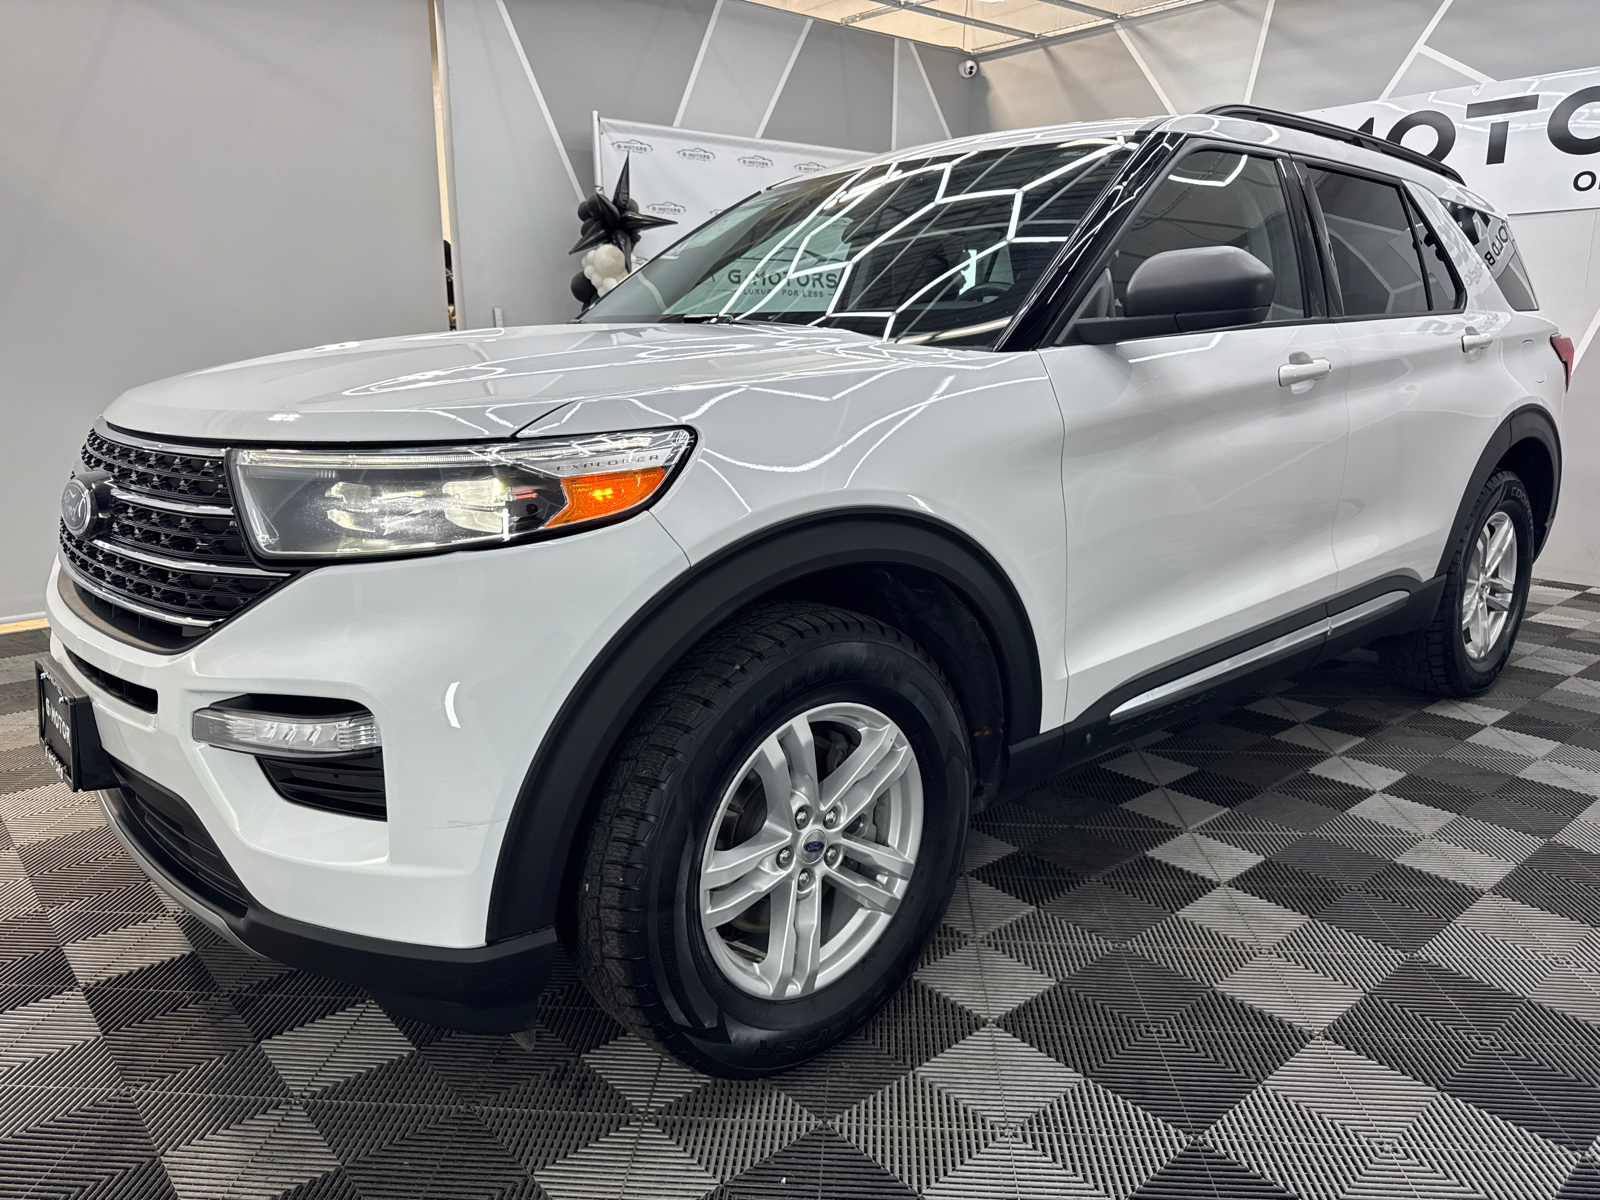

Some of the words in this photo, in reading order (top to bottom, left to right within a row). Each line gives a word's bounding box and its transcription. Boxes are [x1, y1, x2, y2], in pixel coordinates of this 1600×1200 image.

[1356, 86, 1600, 165] OTO
[781, 289, 799, 297] FOR
[802, 290, 824, 298] LESS
